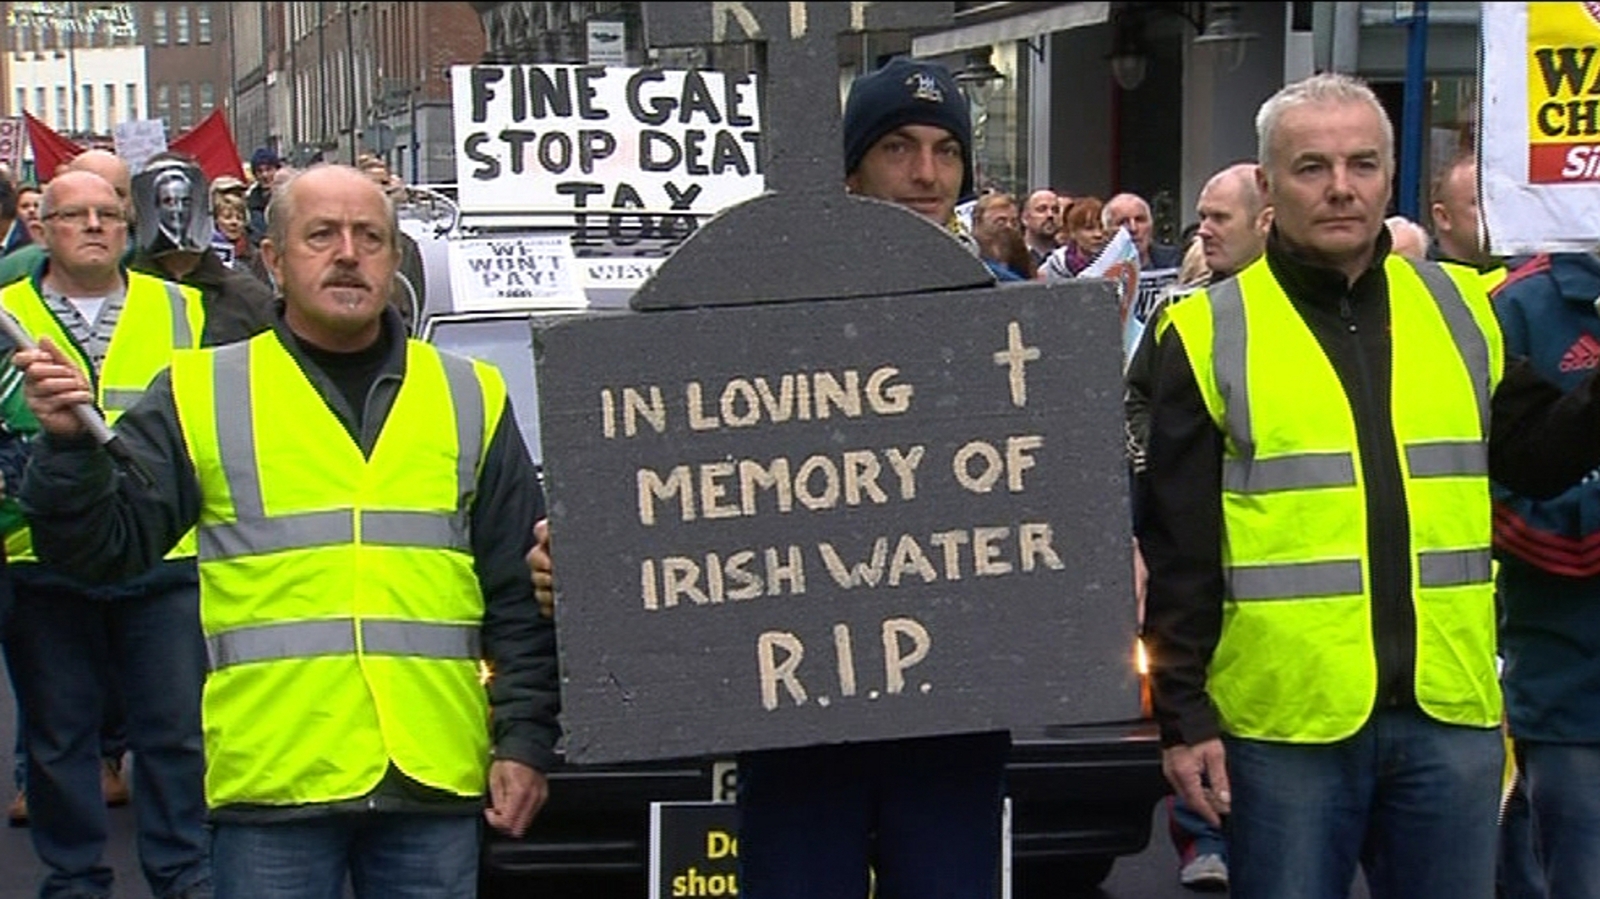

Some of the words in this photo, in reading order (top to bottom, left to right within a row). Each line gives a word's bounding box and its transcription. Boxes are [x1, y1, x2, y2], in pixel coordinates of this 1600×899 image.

[470, 67, 609, 123] FINE
[1534, 47, 1600, 97] W
[464, 129, 617, 181] STOP
[1561, 145, 1600, 178] Si
[468, 255, 563, 272] WON'T
[481, 270, 558, 287] PAY!
[601, 385, 666, 438] IN
[687, 366, 914, 432] LOVING
[635, 445, 926, 526] MEMORY
[952, 435, 1044, 493] OF
[641, 544, 806, 611] IRISH
[819, 522, 1065, 589] WATER
[756, 616, 933, 710] R.I.P.
